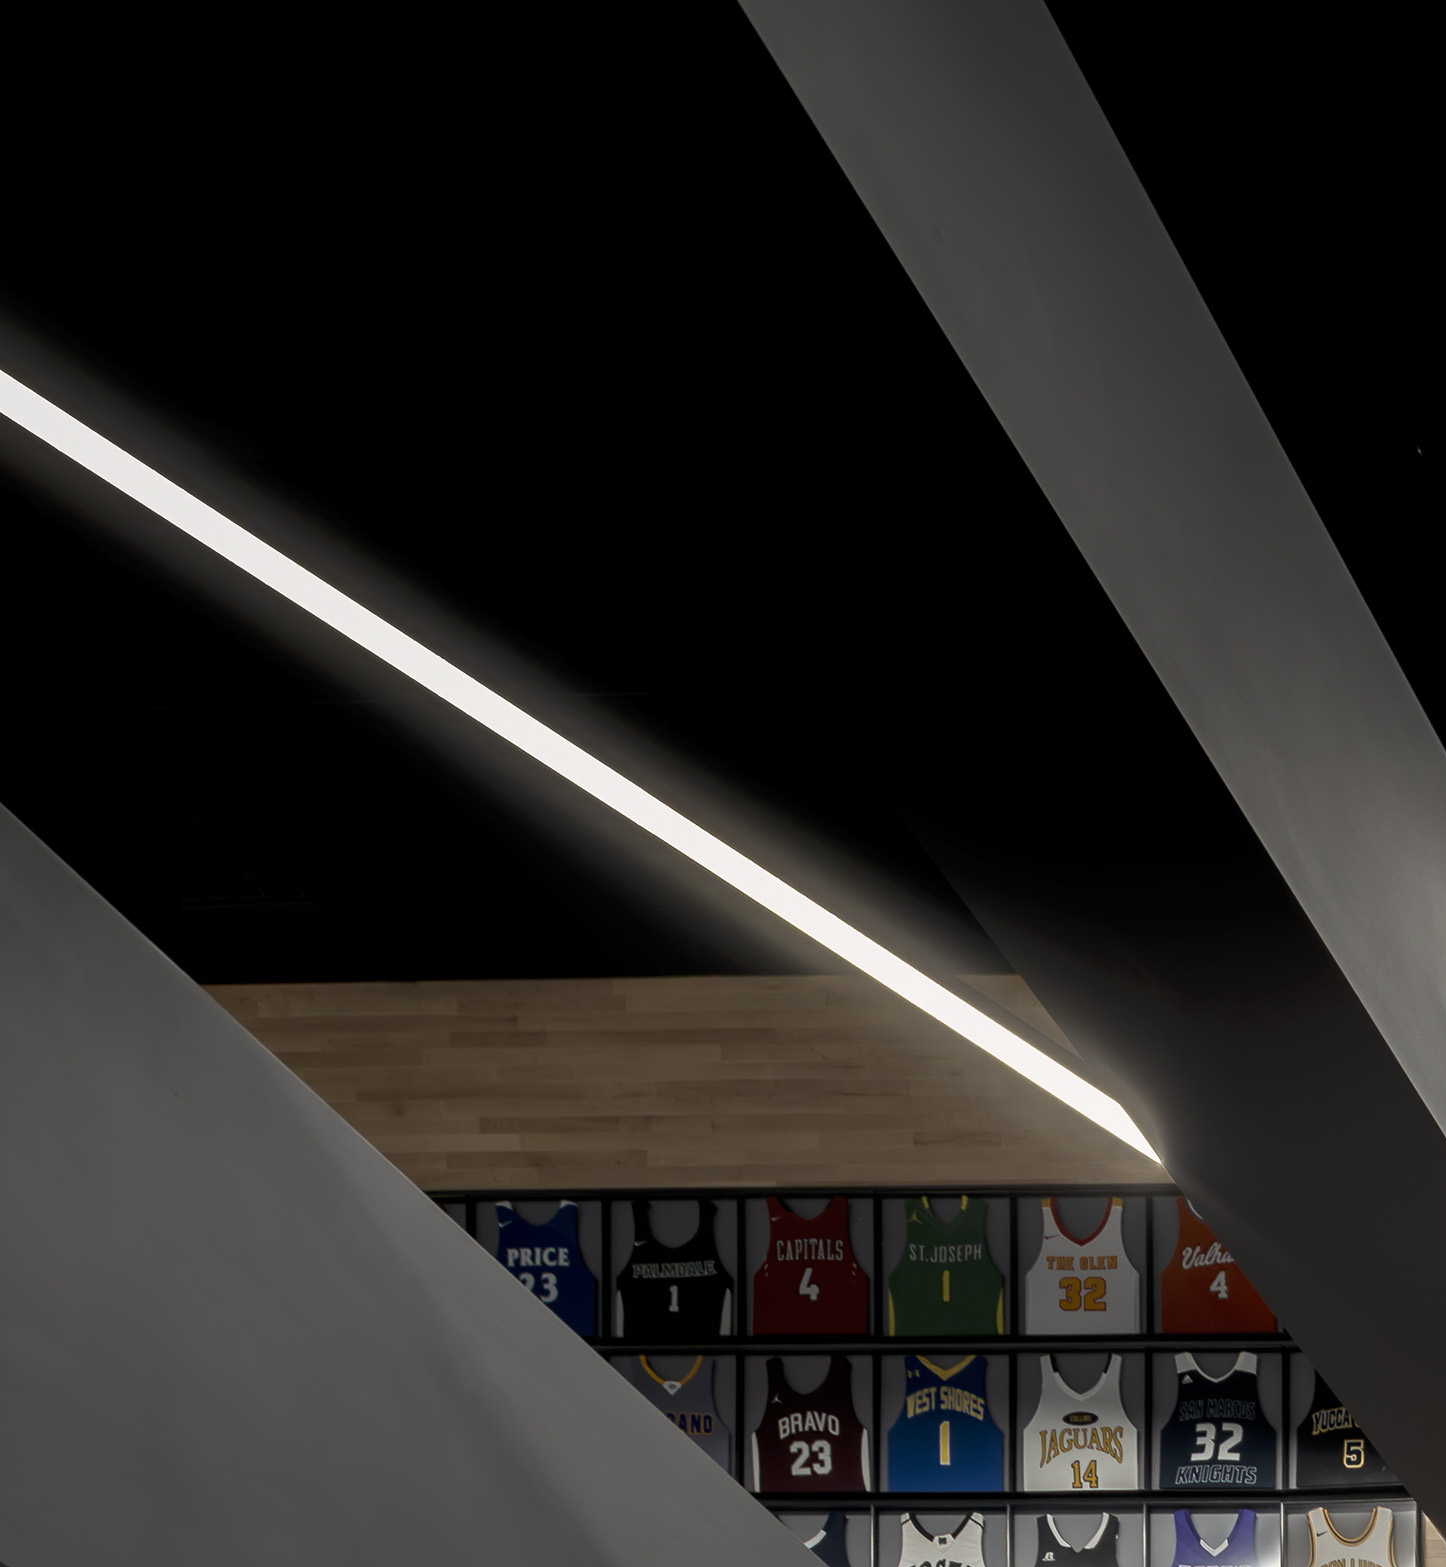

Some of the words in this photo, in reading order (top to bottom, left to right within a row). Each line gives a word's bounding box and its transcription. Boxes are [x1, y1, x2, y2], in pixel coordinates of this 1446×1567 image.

[507, 1248, 570, 1268] PRICE
[776, 1238, 844, 1262] CAPITALS
[907, 1392, 938, 1420] WEST
[942, 1387, 985, 1422] SHORES
[779, 1412, 840, 1439] BRAVO
[790, 1441, 832, 1476] 23
[1040, 1427, 1123, 1466] JAGUARS
[1175, 1465, 1257, 1484] KNIGHTS
